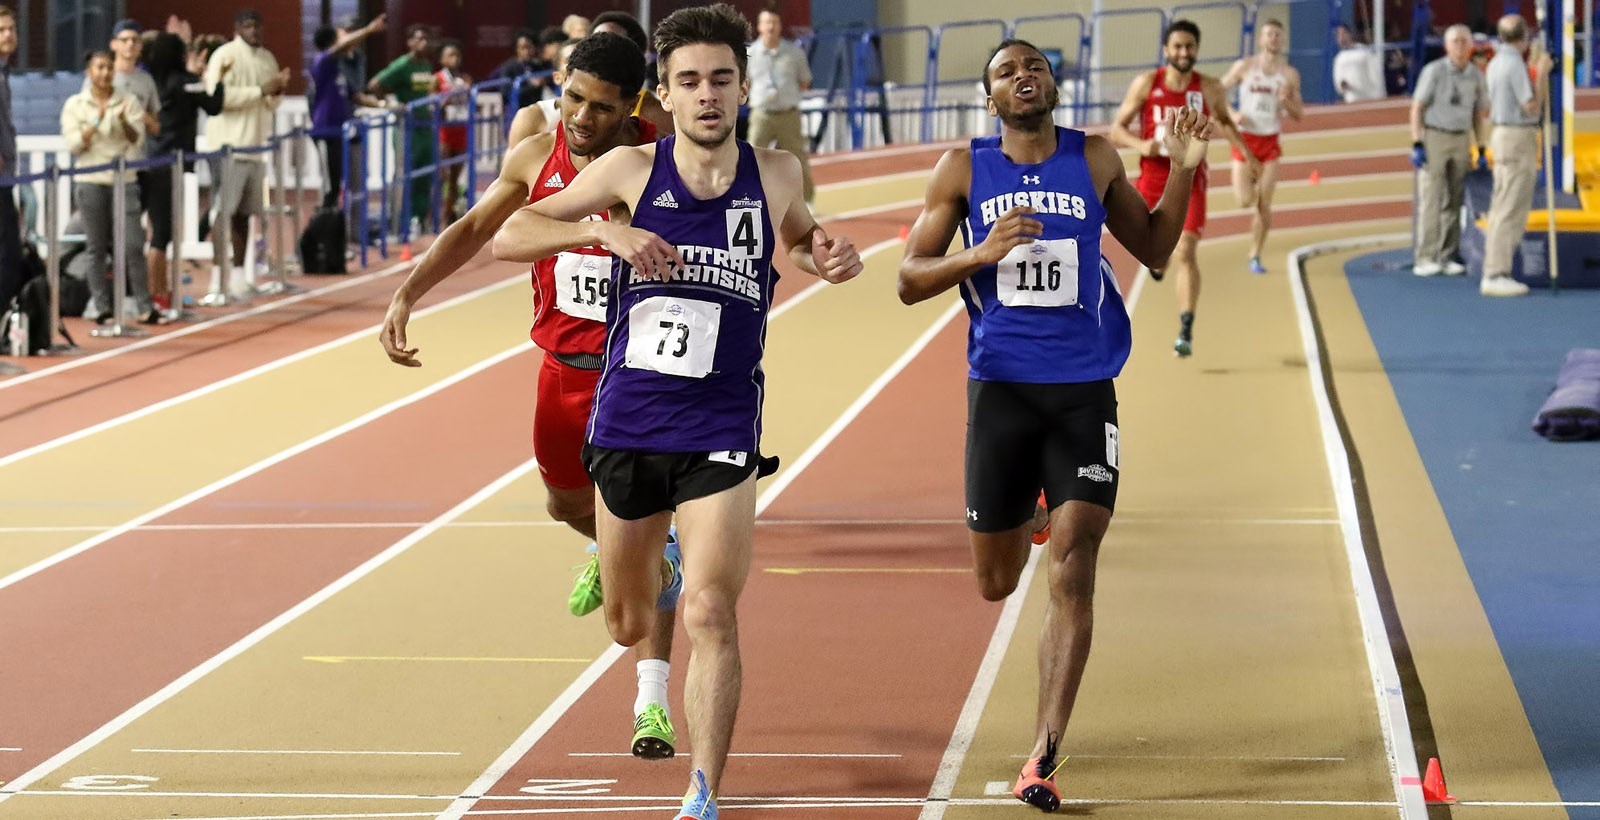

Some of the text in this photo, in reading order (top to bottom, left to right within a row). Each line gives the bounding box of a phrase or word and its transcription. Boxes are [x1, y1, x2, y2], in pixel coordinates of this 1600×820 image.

[652, 199, 679, 208] adidas
[980, 191, 1086, 227] HUSKIES
[732, 211, 758, 256] 4
[664, 245, 759, 279] NTRAL
[1016, 260, 1061, 292] 116
[571, 274, 611, 307] 159
[656, 320, 690, 358] 73
